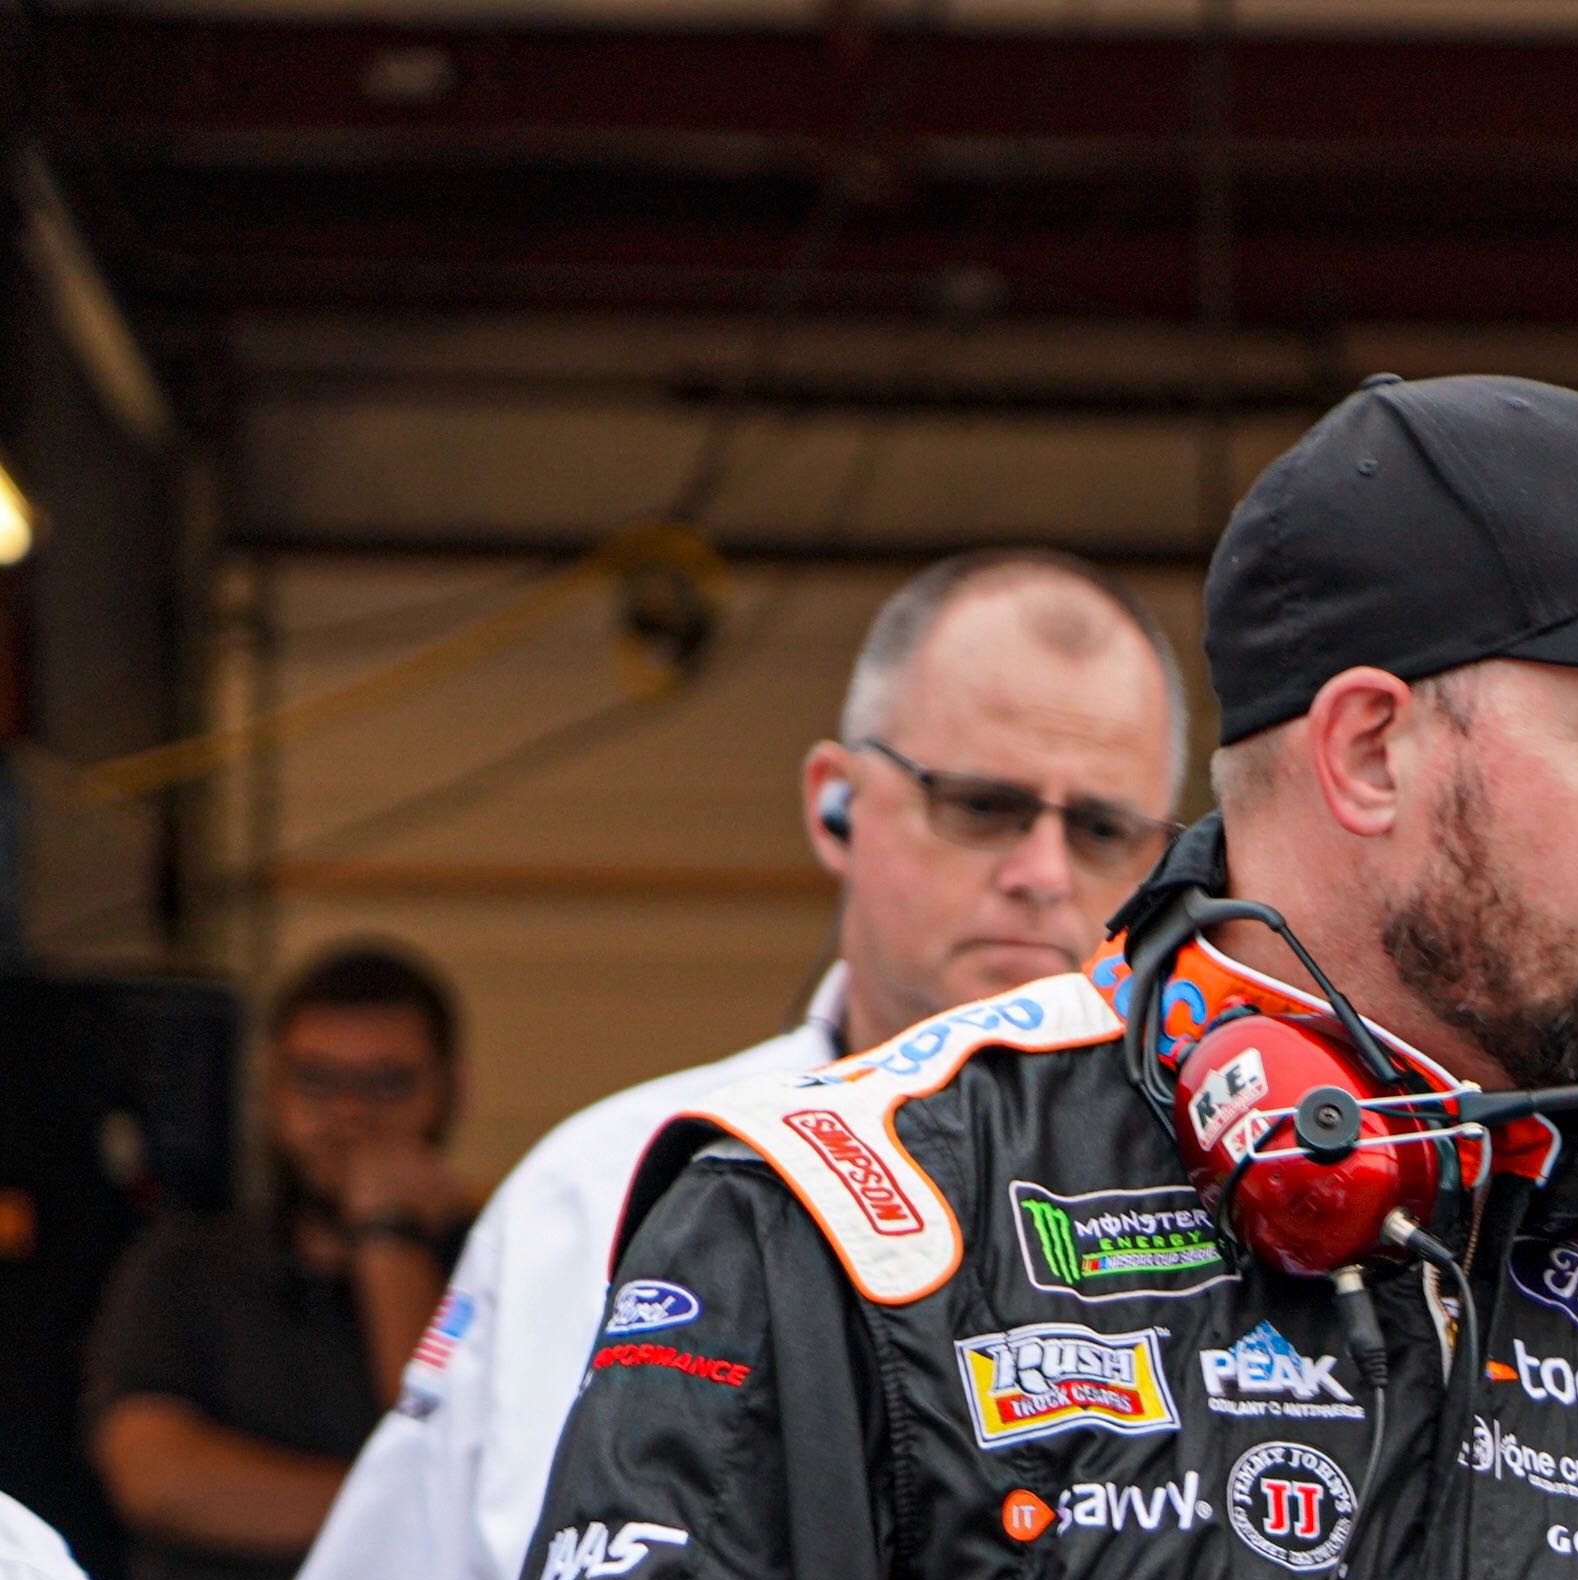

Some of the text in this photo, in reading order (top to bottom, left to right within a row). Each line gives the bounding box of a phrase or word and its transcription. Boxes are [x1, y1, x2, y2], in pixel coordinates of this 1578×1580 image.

[803, 1117, 908, 1221] SIMPSON
[1100, 1230, 1202, 1251] ENERGY
[986, 1337, 1137, 1396] RUSH
[1200, 1349, 1354, 1401] PEAK
[1503, 1444, 1556, 1477] one
[1012, 1505, 1034, 1529] IT
[1056, 1470, 1200, 1537] savvy
[1261, 1477, 1324, 1539] JJ
